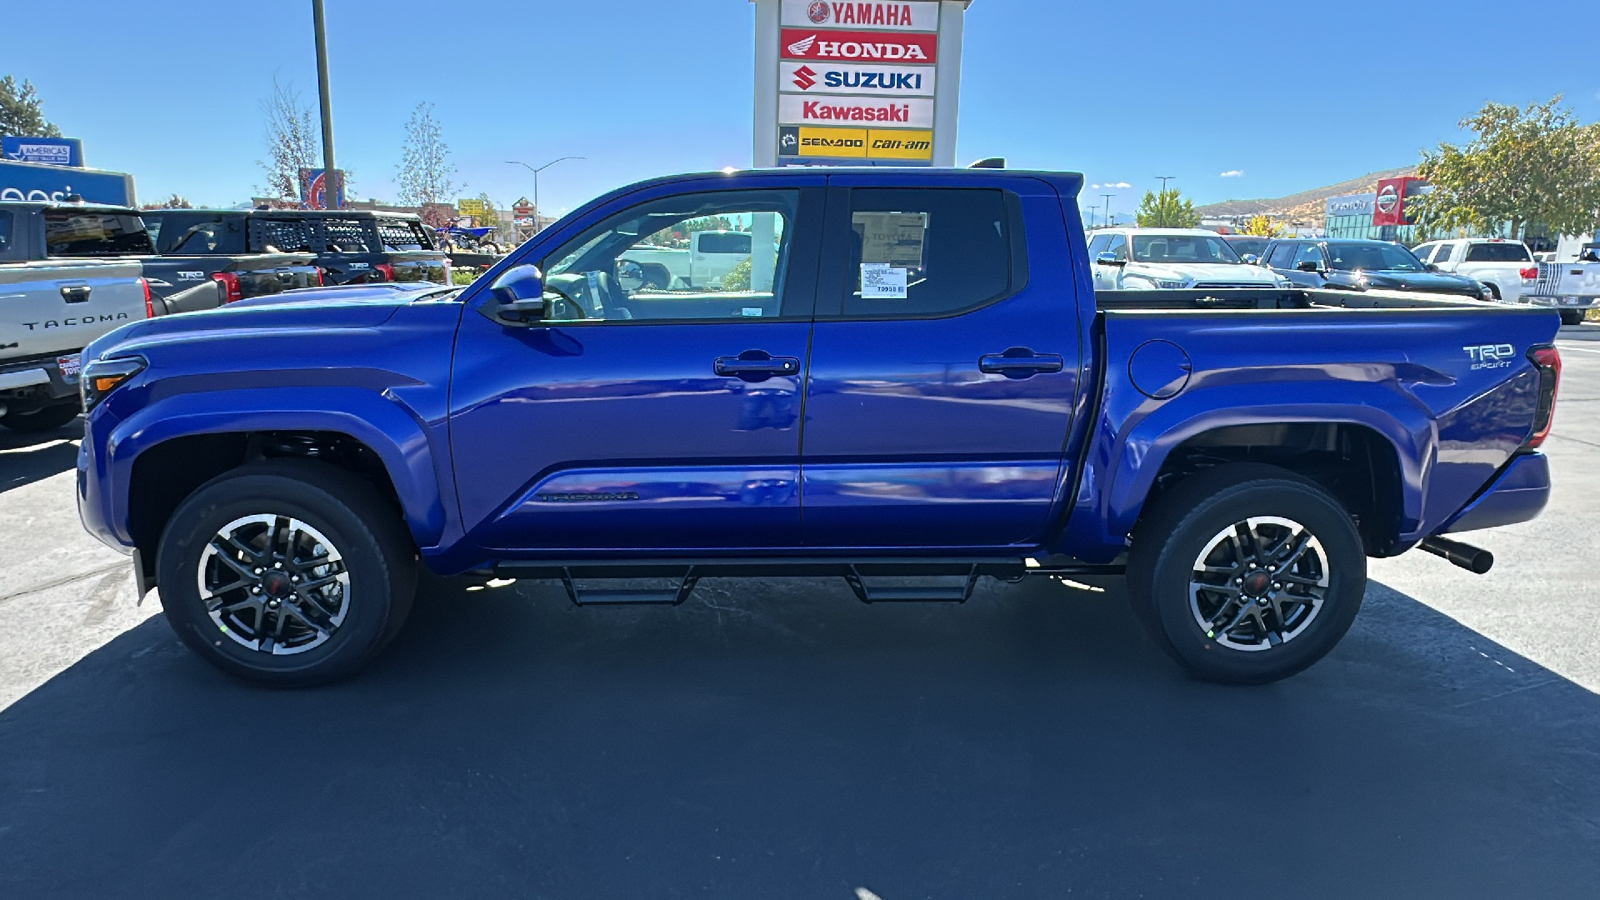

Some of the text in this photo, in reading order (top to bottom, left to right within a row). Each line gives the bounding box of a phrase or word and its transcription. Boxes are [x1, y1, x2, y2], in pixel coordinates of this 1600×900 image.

[833, 3, 912, 26] YAMAHA
[817, 41, 927, 59] HONDA
[824, 71, 922, 89] SUZUKI
[803, 101, 909, 122] Kawasaki
[25, 146, 68, 155] AMERICAS
[22, 312, 128, 331] TACOMA
[1463, 344, 1514, 361] TRD
[1470, 361, 1511, 370] SPORT
